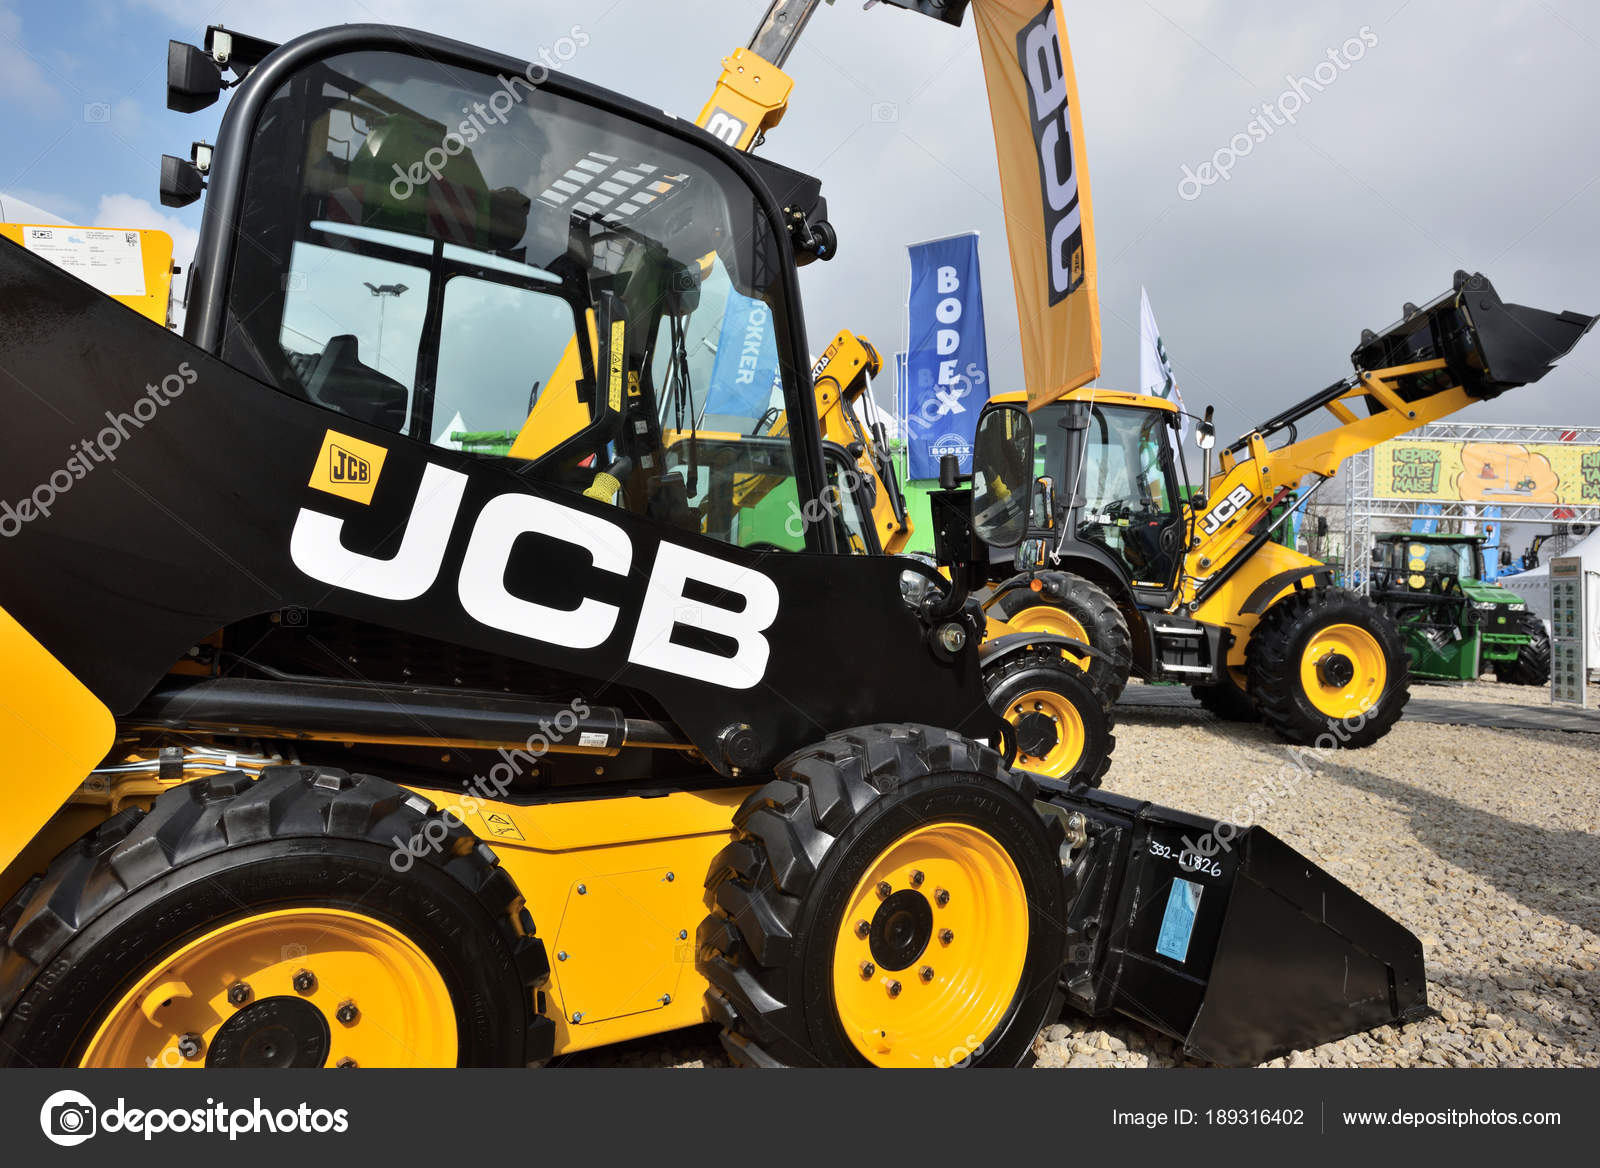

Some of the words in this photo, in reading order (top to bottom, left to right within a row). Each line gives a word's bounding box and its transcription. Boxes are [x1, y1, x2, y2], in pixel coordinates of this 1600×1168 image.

[1026, 8, 1081, 293] JCB
[935, 265, 967, 416] BODEX
[334, 450, 368, 481] JCB
[931, 446, 970, 455] BODEX
[1203, 485, 1253, 535] JCB
[290, 462, 779, 690] JCB
